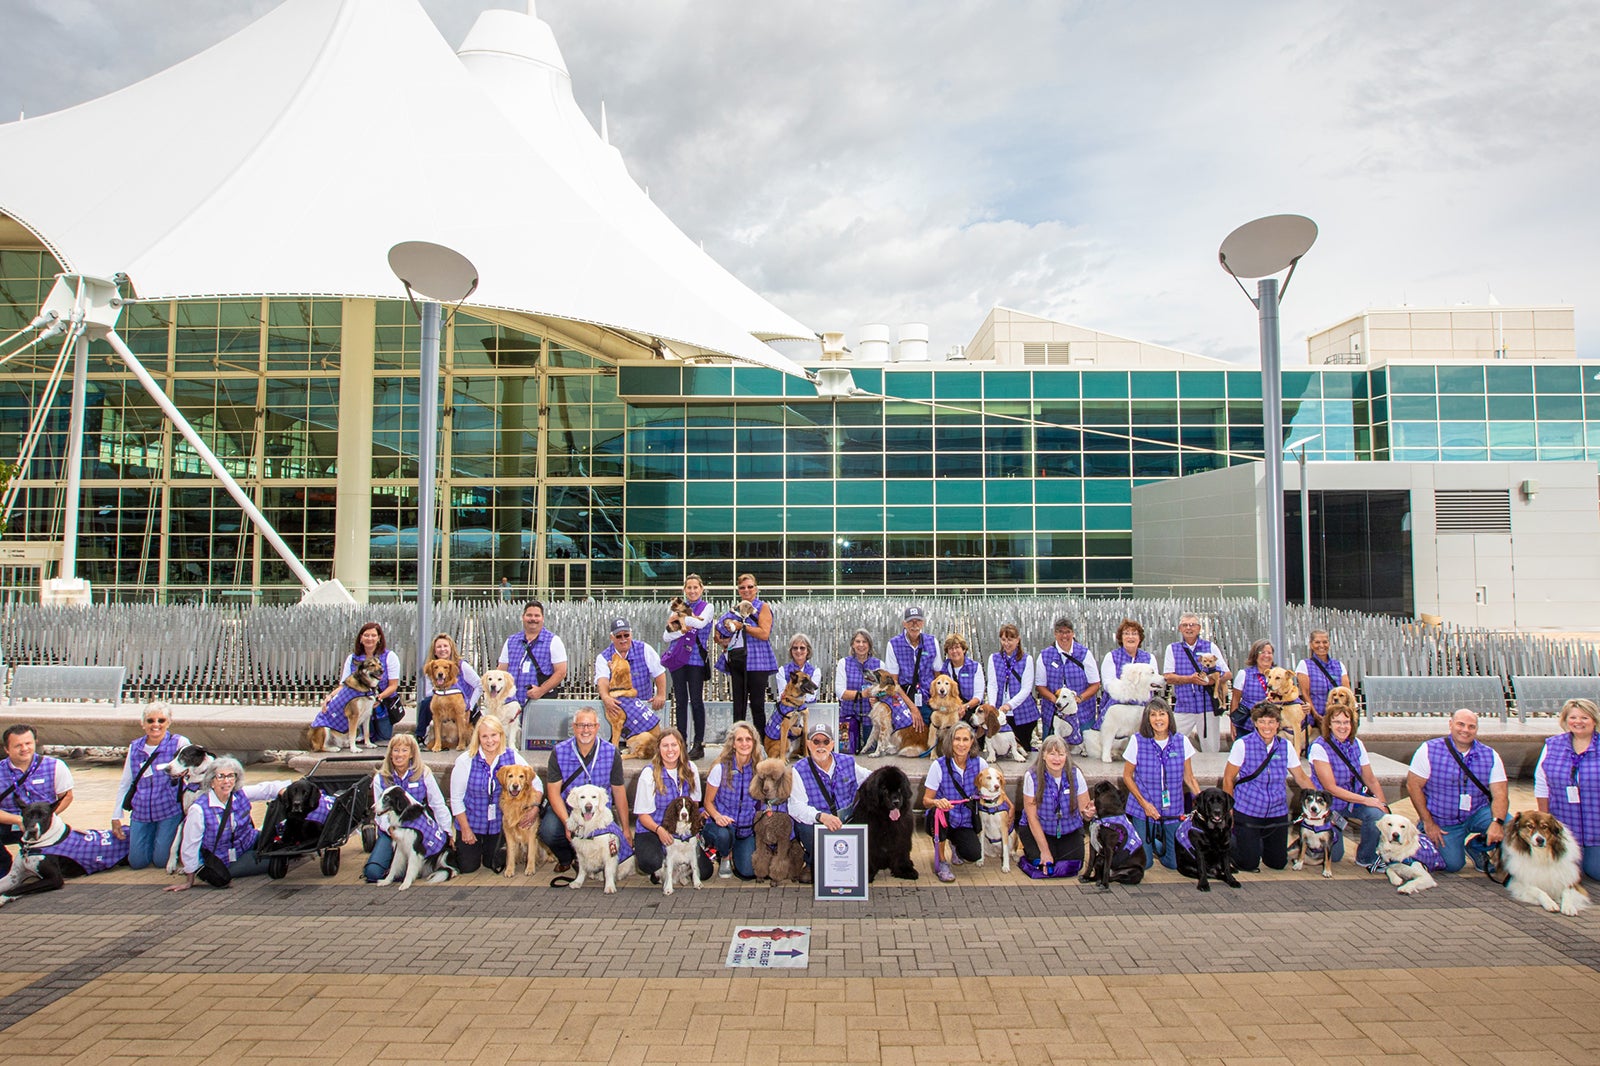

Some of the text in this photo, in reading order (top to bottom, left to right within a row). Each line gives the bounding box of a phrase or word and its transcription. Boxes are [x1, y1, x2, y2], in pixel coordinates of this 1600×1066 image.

[734, 943, 746, 954] THIS
[748, 947, 757, 960] AREA
[760, 941, 772, 966] PET RELIEF
